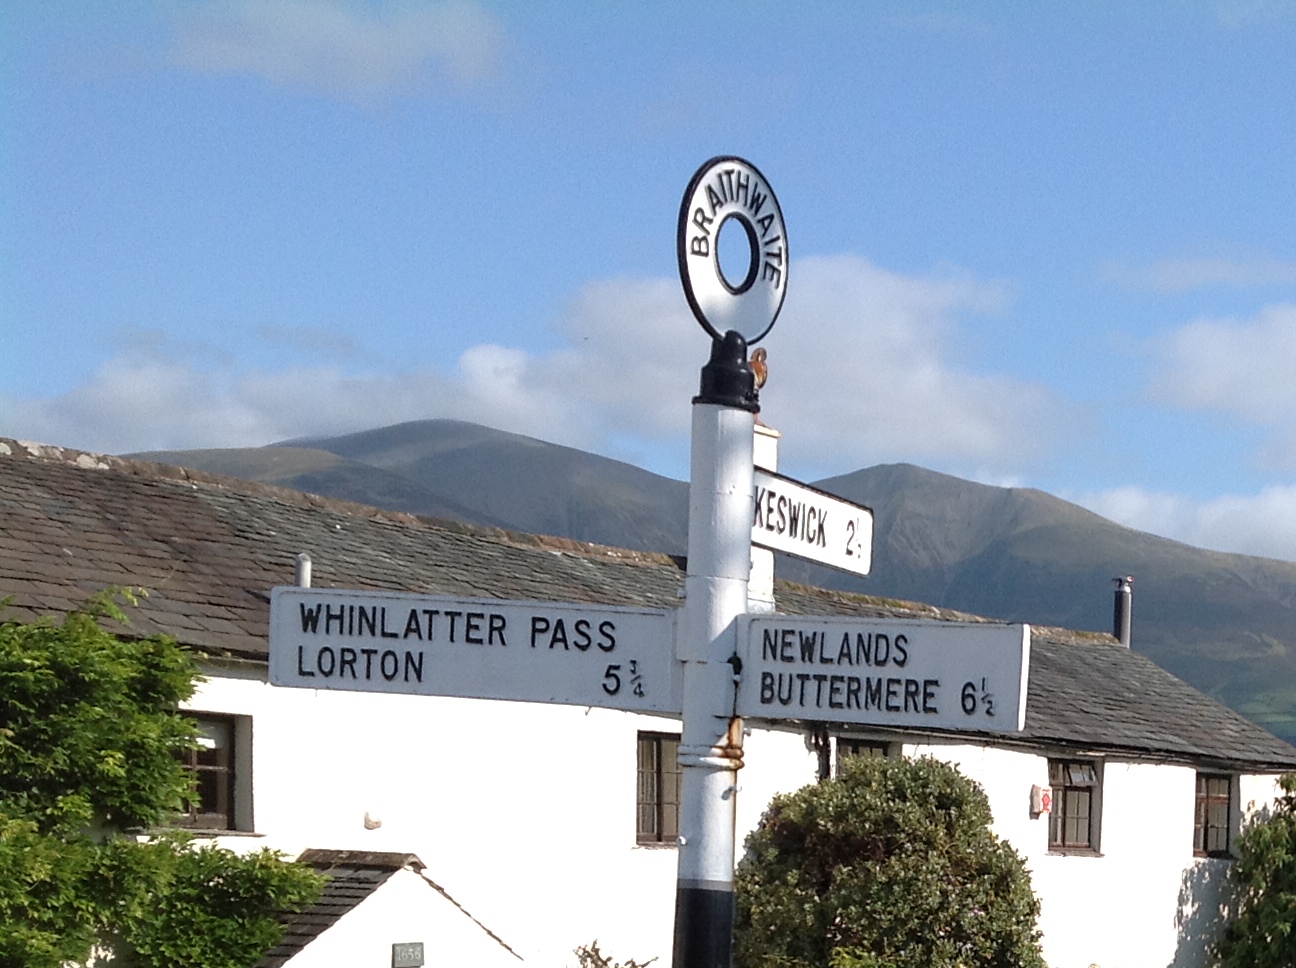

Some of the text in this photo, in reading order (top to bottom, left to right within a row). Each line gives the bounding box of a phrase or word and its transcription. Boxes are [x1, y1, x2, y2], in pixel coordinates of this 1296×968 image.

[690, 167, 782, 289] BRAITHWAITE
[752, 485, 828, 548] KESWICK
[299, 602, 617, 653] WHINLATTER PASS
[761, 628, 909, 668] NEWLANDS
[297, 645, 424, 683] LORTON
[760, 671, 940, 715] BUTTERMERE
